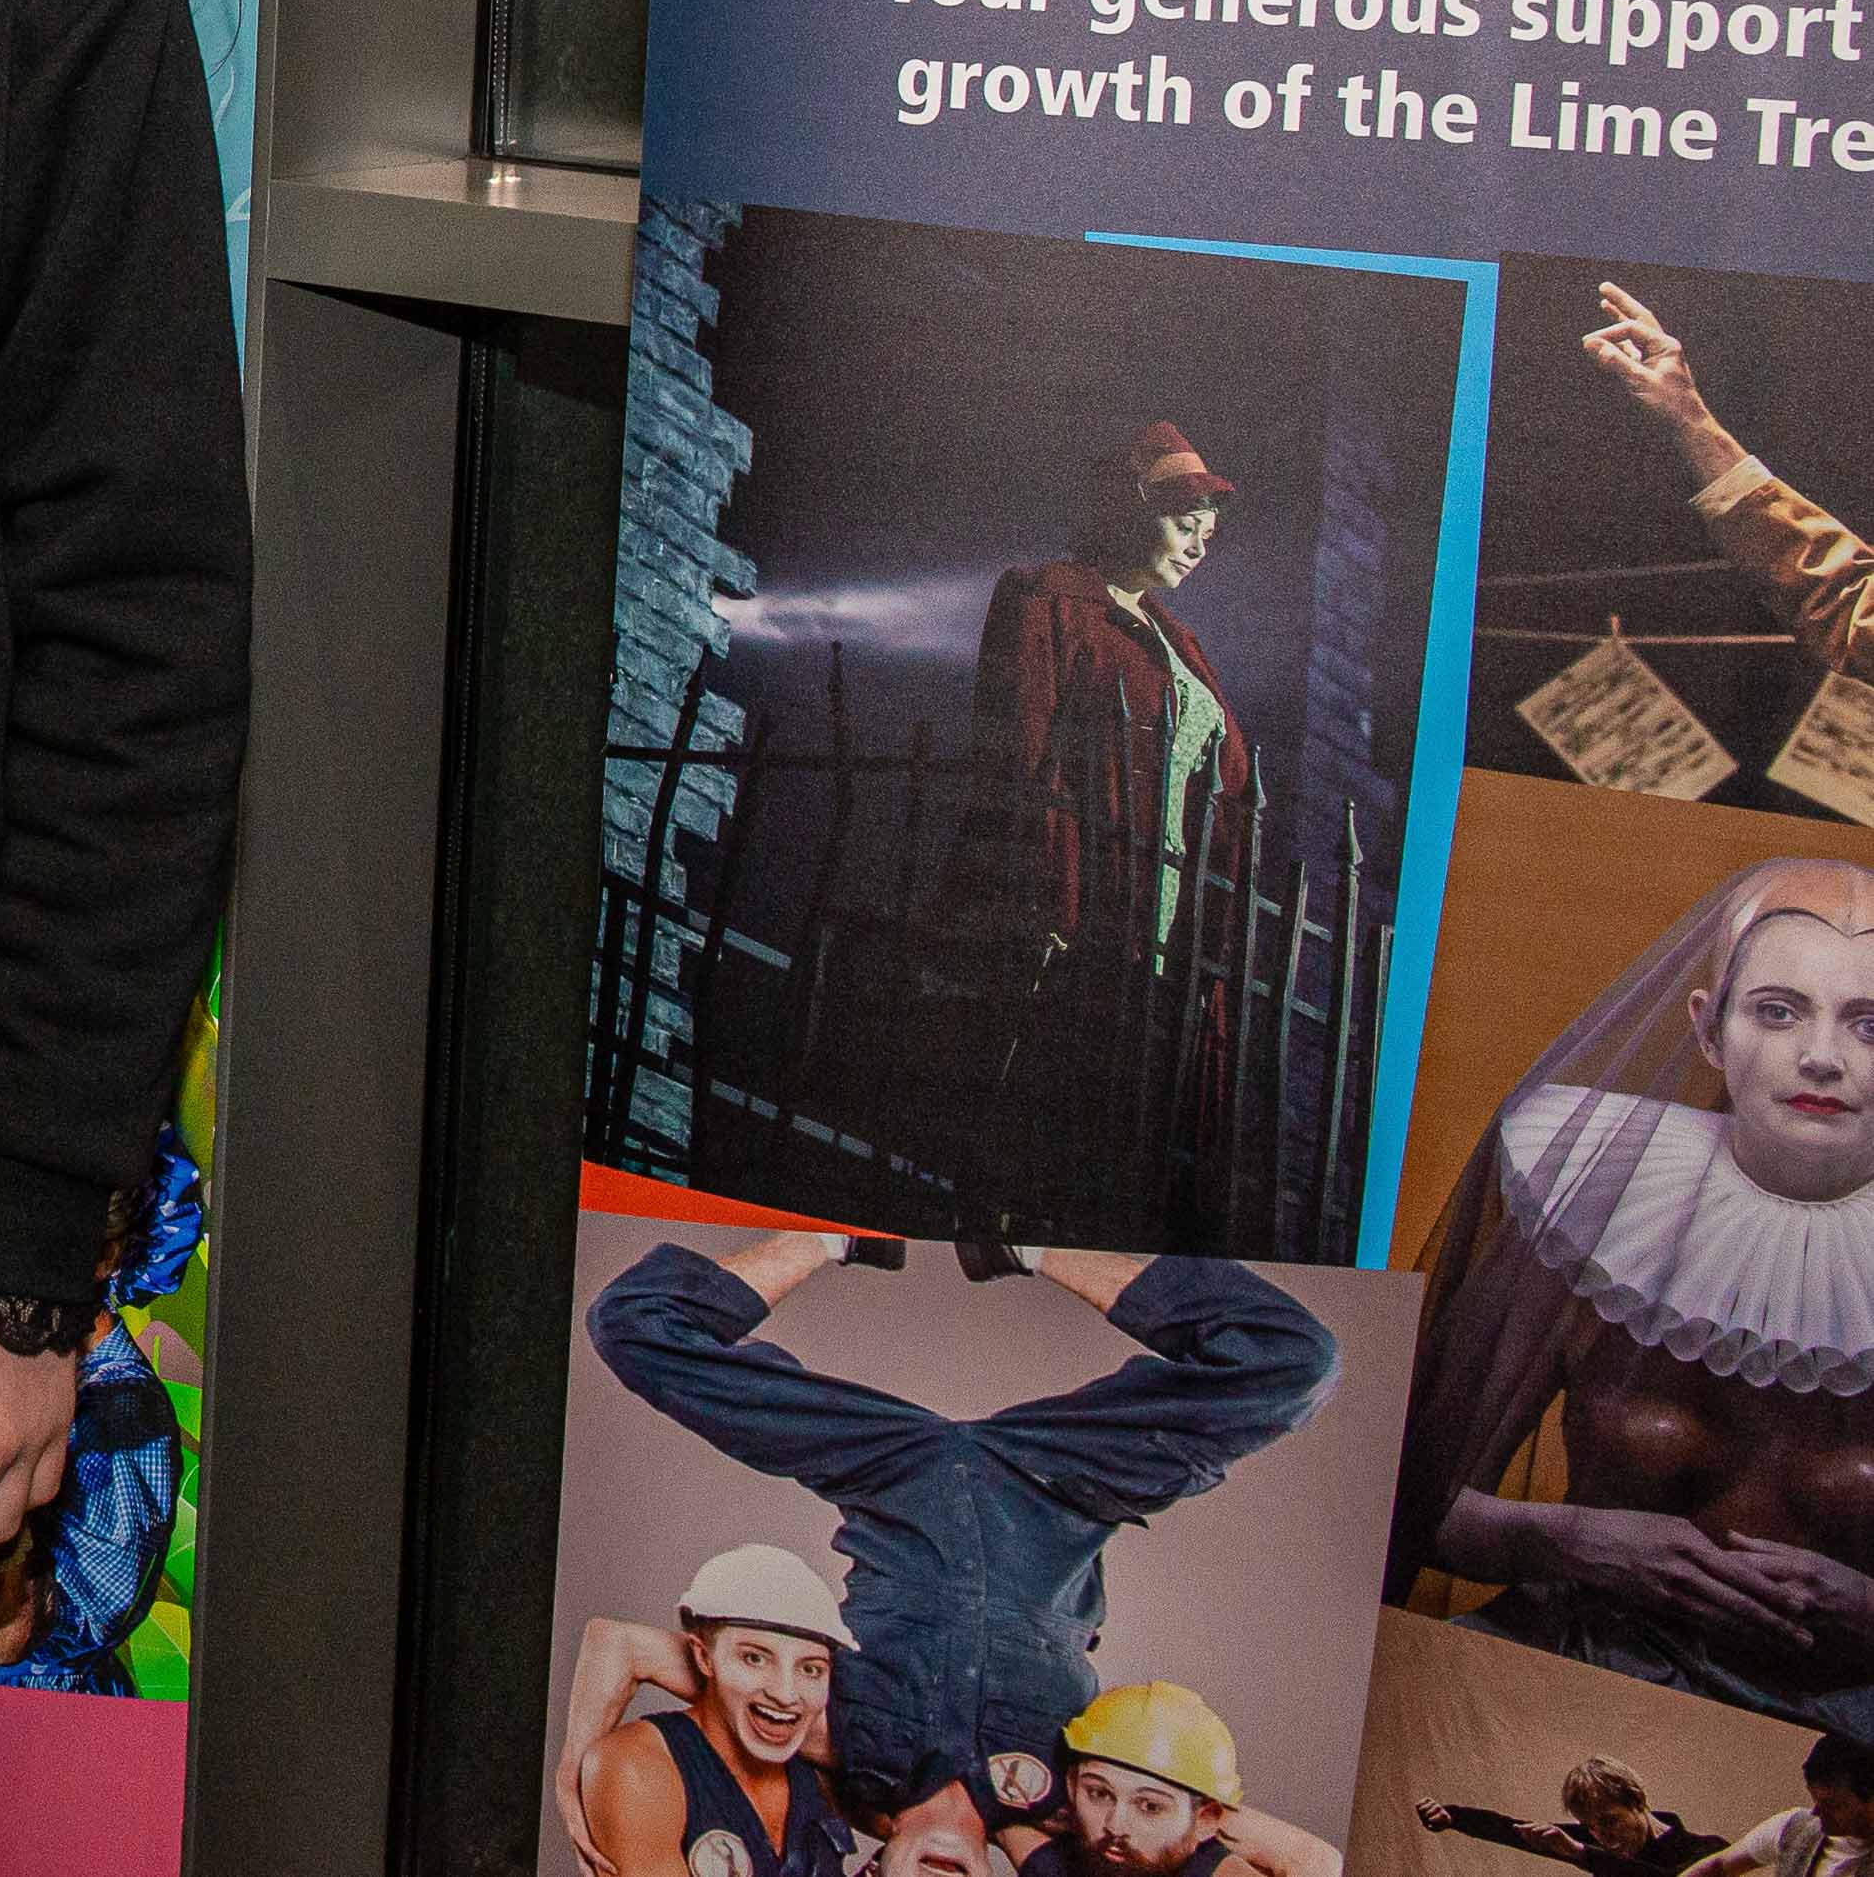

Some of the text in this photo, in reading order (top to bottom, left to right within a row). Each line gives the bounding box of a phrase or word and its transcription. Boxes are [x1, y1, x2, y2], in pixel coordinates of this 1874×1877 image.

[897, 54, 1193, 126] growth
[1223, 63, 1314, 132] of
[1338, 69, 1478, 144] the
[1511, 81, 1718, 161] Lime
